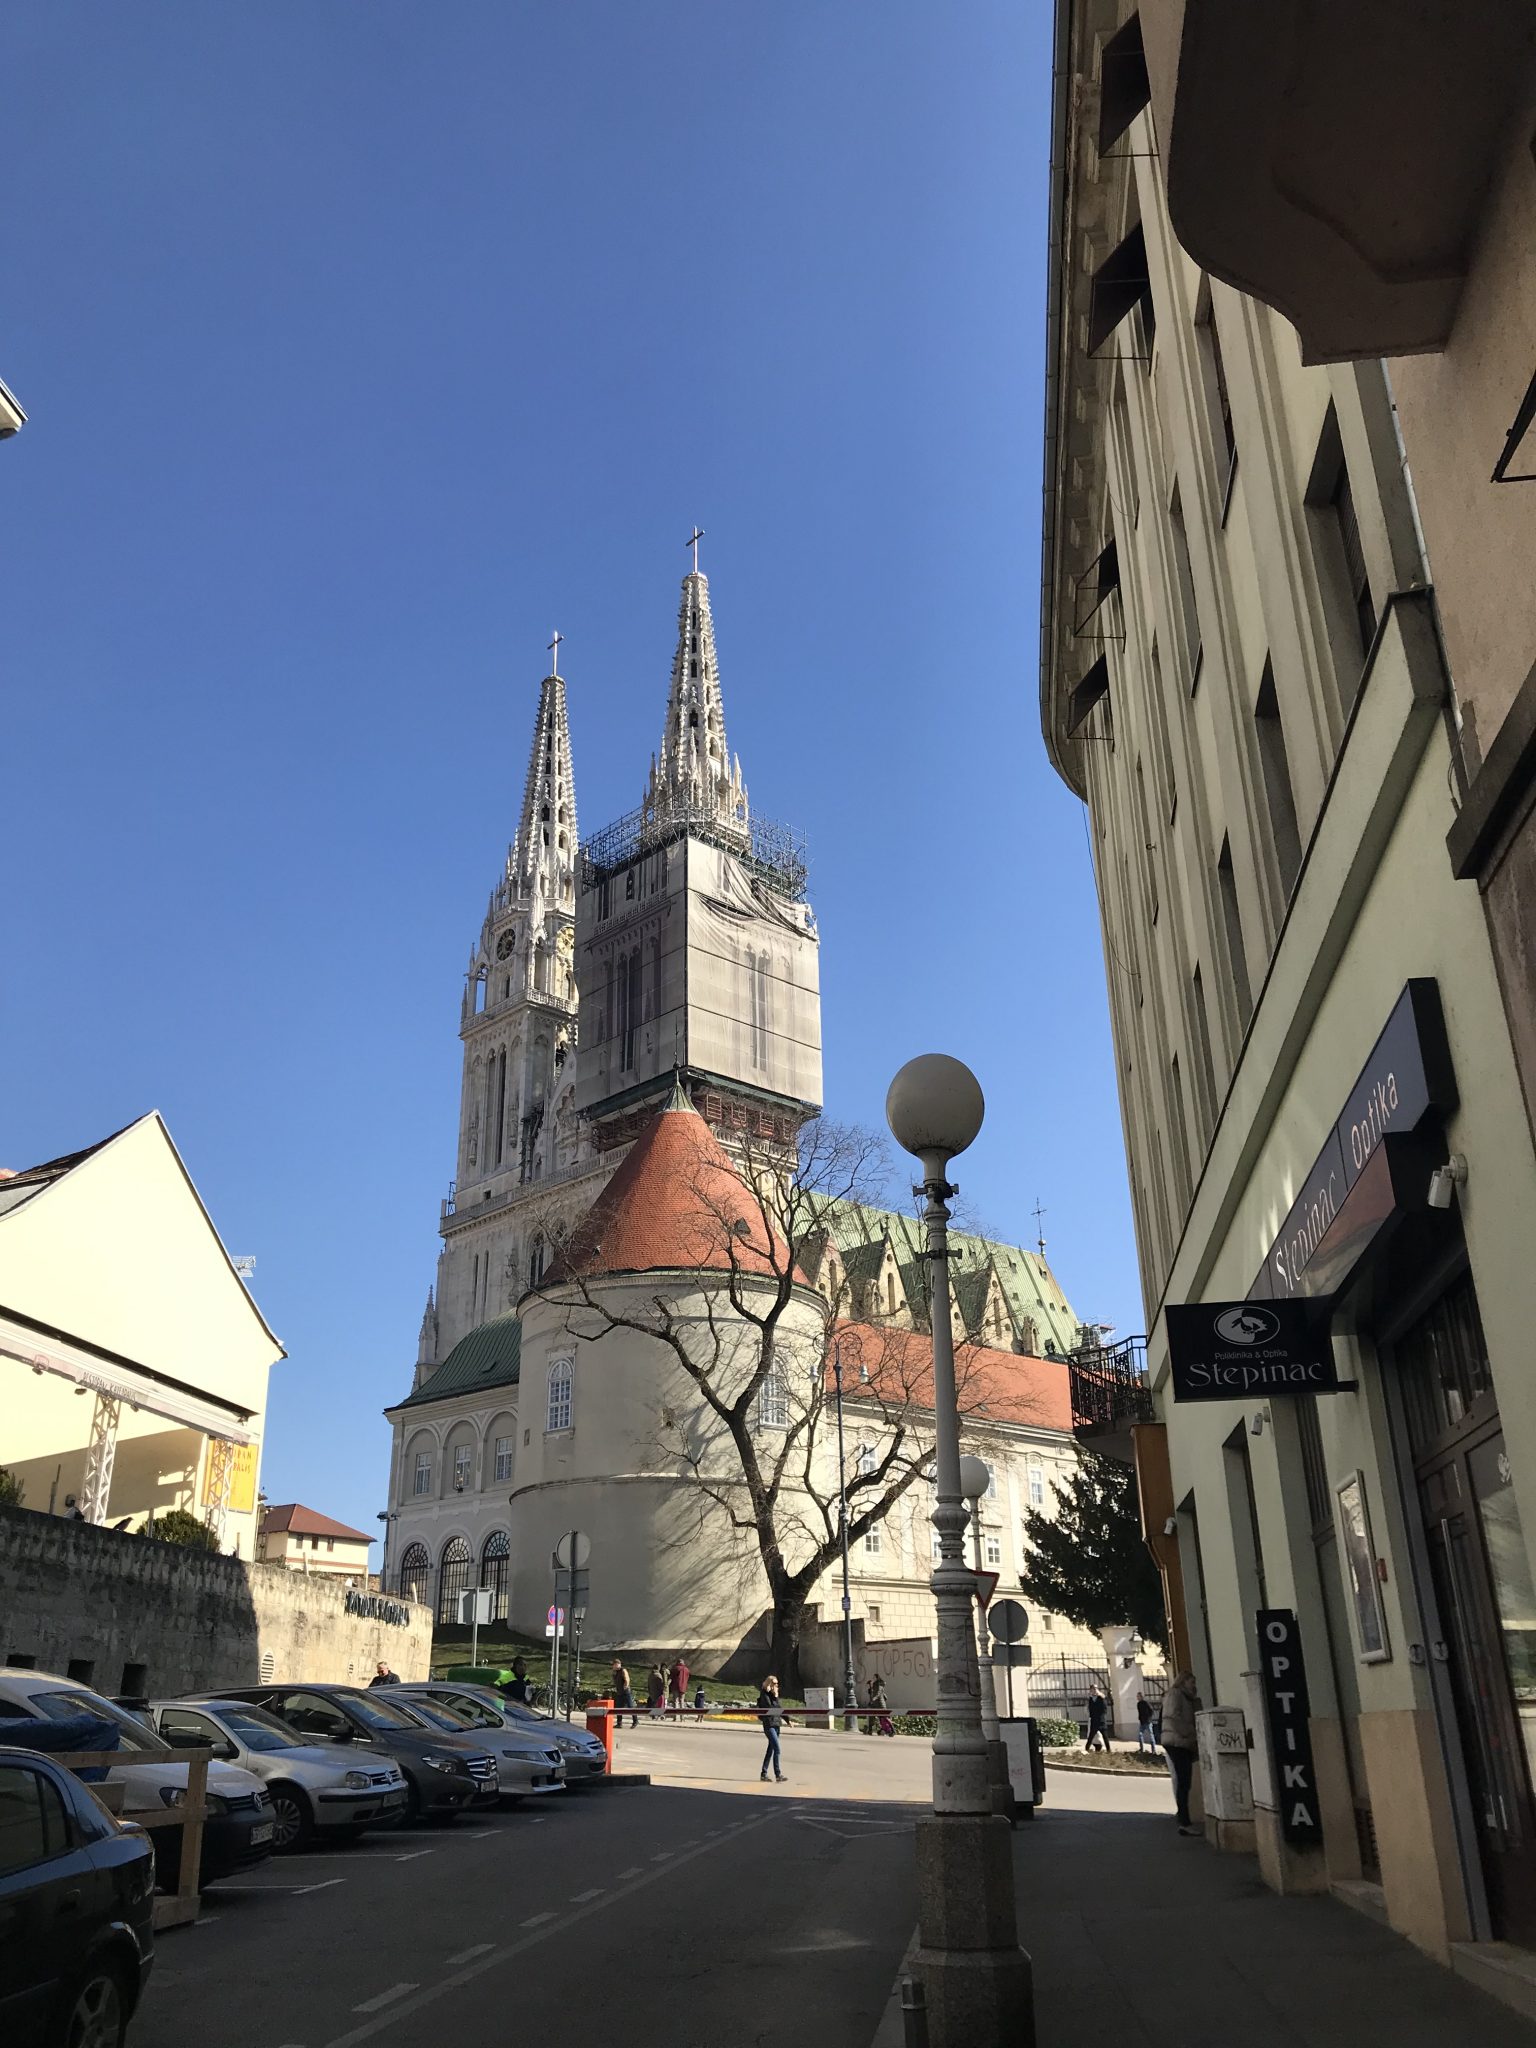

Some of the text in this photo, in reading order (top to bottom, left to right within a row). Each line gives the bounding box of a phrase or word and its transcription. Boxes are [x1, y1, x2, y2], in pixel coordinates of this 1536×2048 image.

[1351, 1072, 1399, 1170] Optika
[1214, 1349, 1289, 1361] Poliklinika & Optika
[1185, 1360, 1324, 1390] Stepinac
[856, 1646, 932, 1684] STOP 5G!
[1266, 1621, 1314, 1826] OPTIKA
